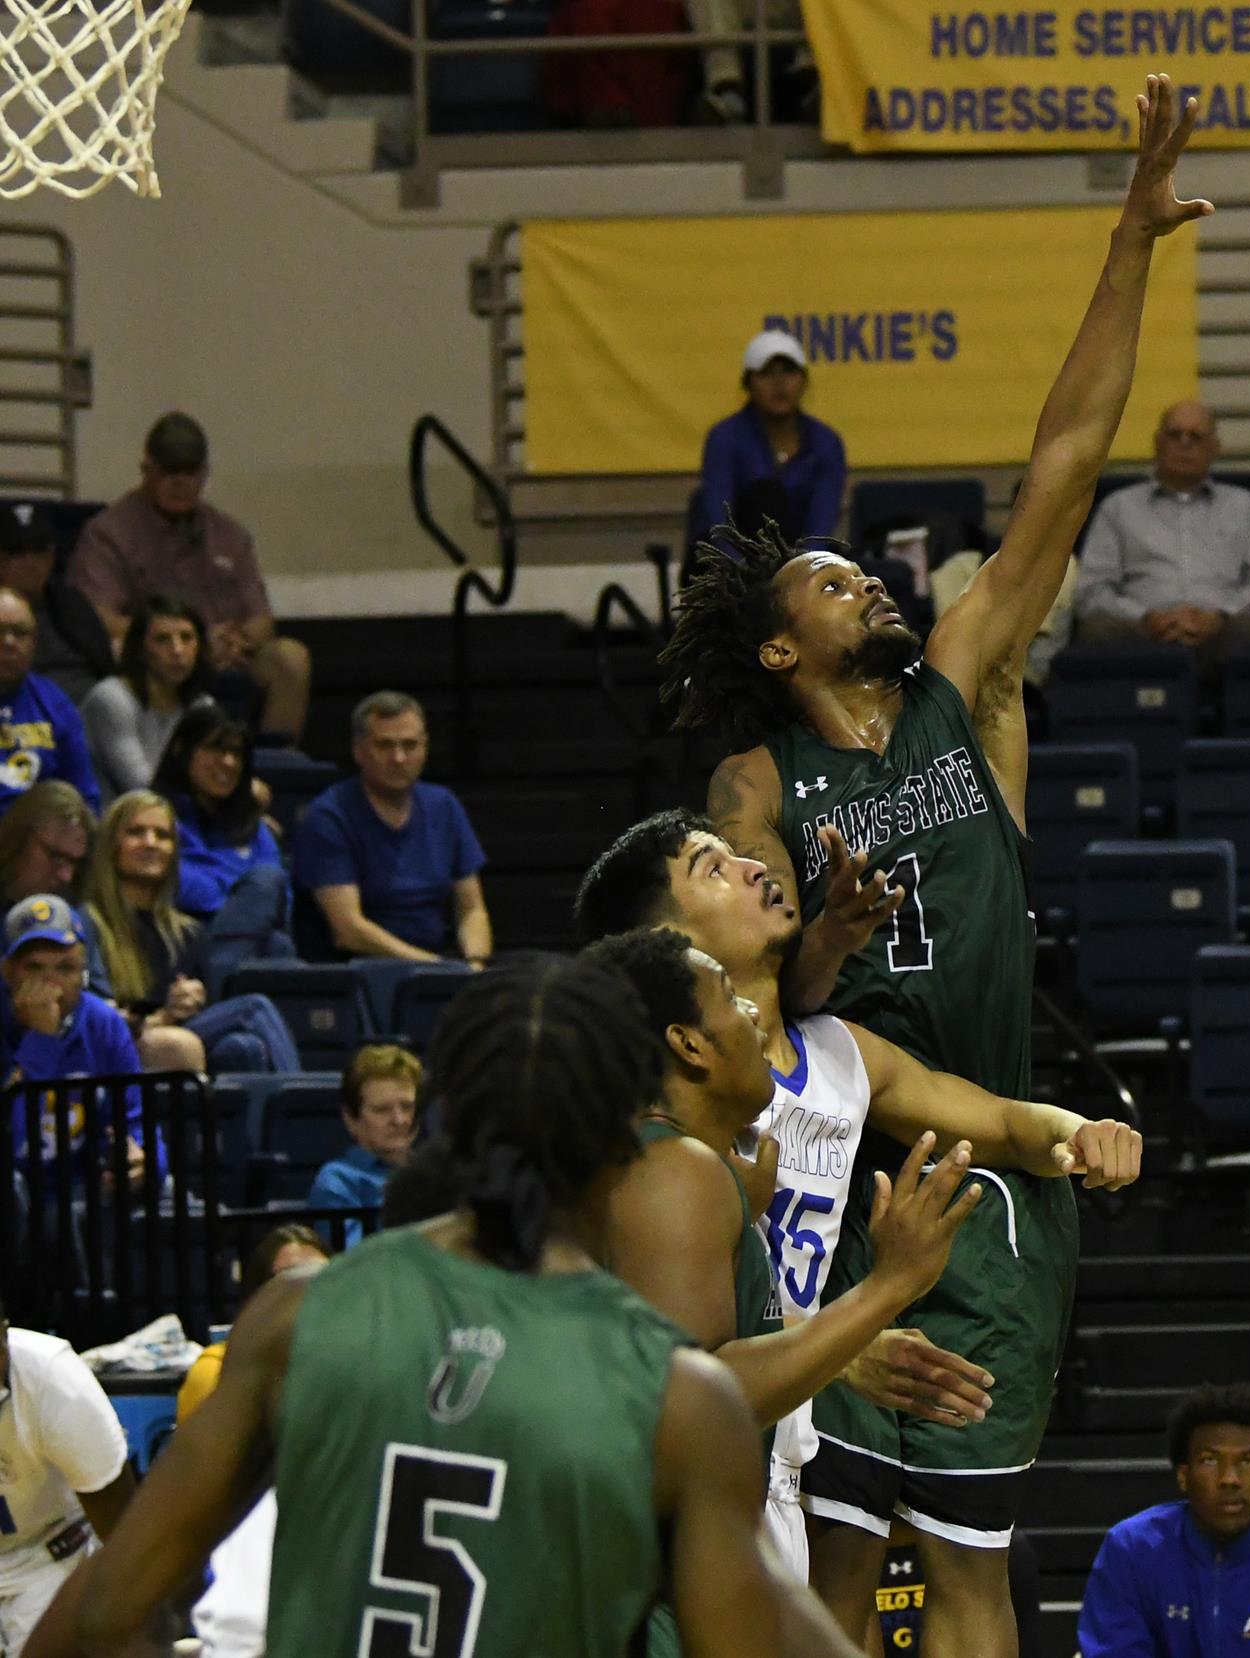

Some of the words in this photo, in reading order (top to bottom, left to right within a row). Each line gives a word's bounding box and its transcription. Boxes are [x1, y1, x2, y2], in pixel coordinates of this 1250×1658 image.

[931, 11, 1057, 58] HOME
[863, 84, 1131, 140] ADDRESSES,
[802, 792, 892, 882] AAMS
[896, 746, 989, 836] STATE
[884, 852, 934, 973] 1
[765, 1187, 836, 1309] 15
[357, 1442, 508, 1658] 5
